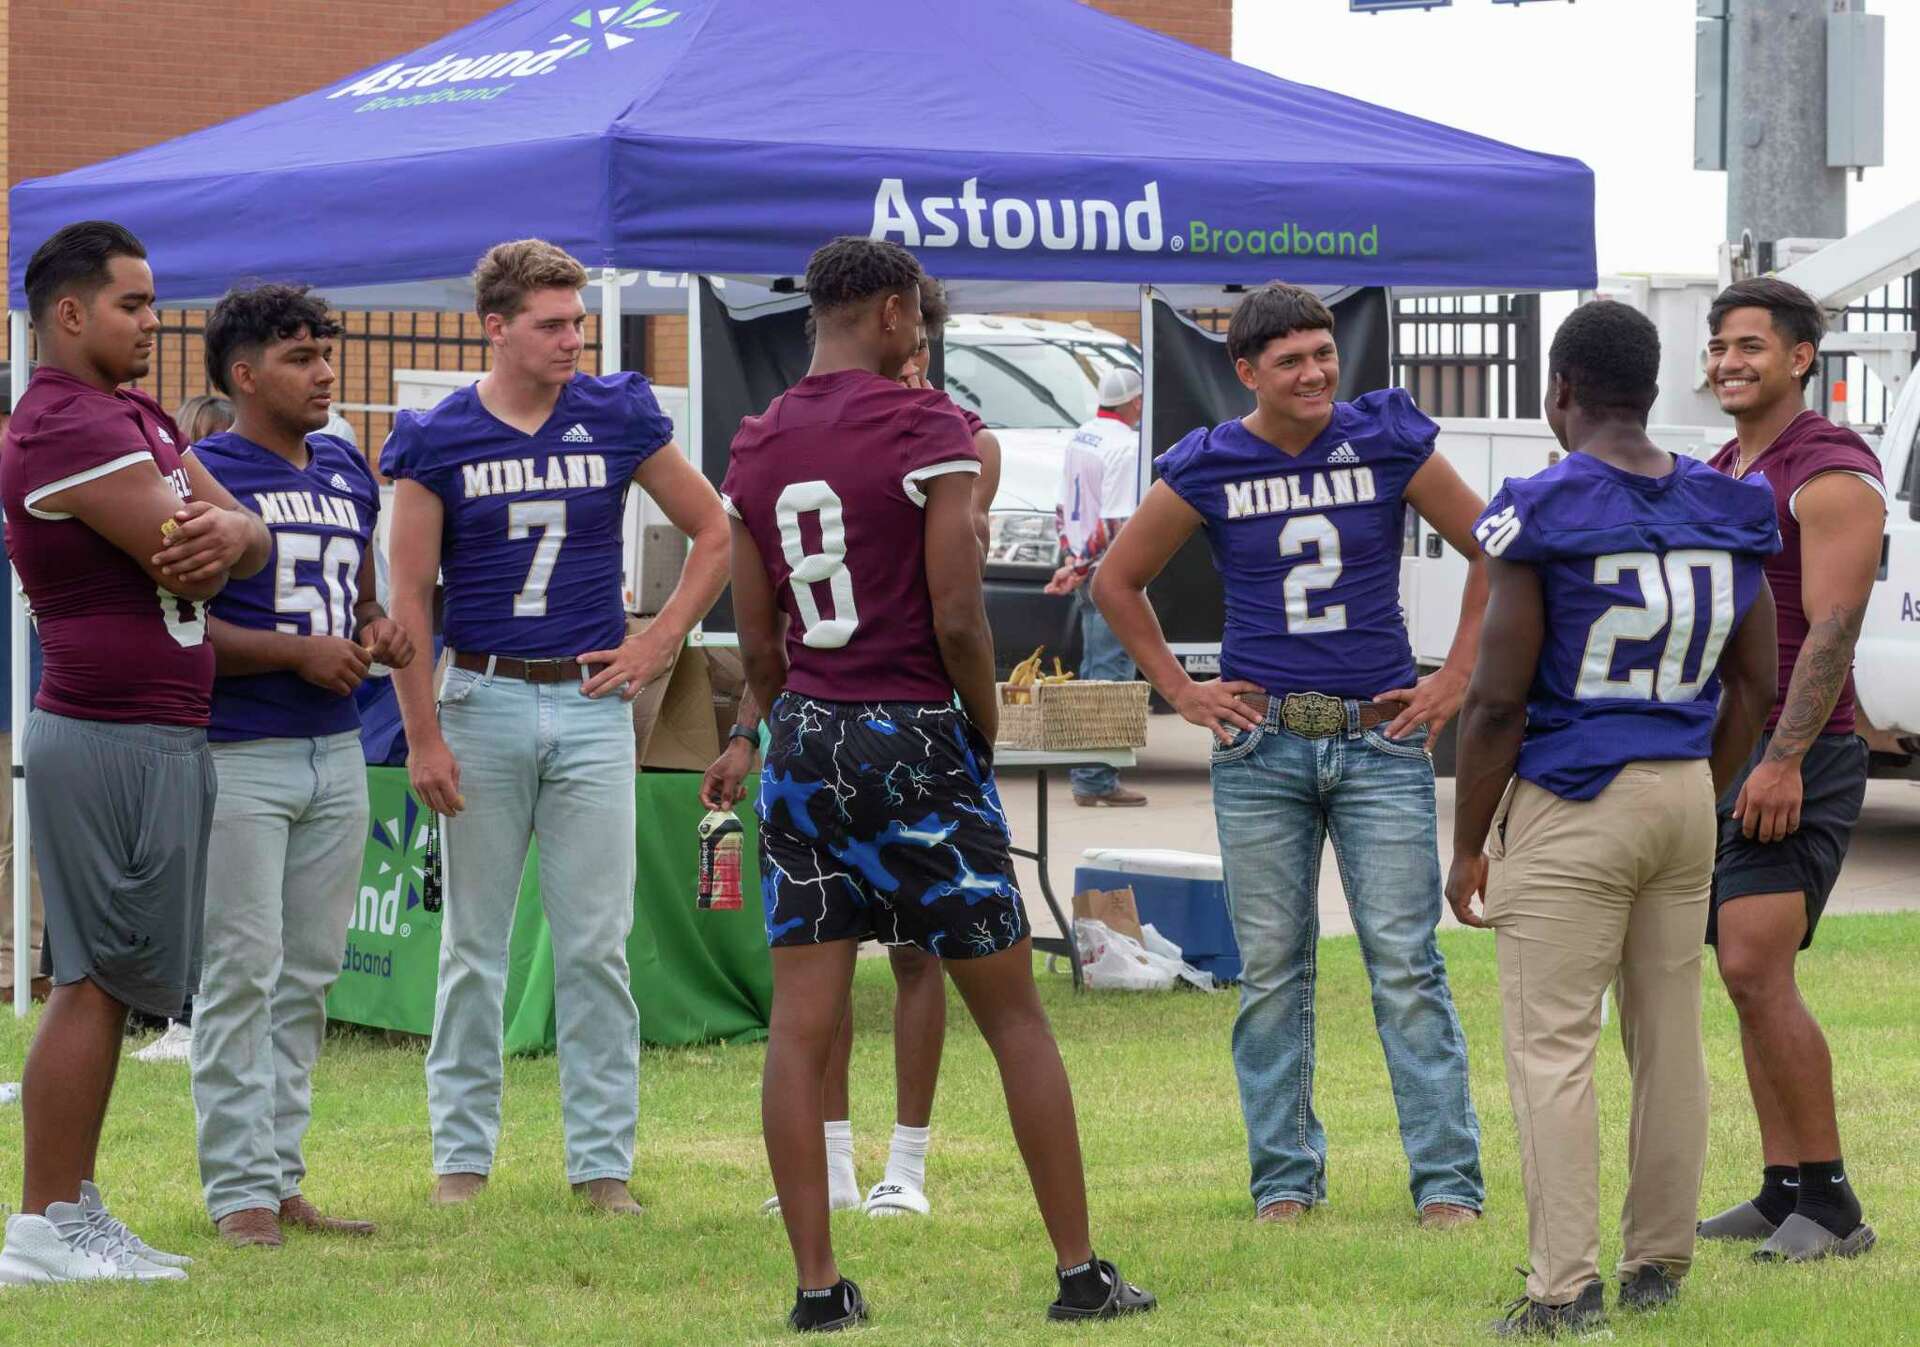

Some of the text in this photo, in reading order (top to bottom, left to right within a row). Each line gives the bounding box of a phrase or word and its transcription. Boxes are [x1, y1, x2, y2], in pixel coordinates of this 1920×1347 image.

[1189, 221, 1379, 256] Broadband
[561, 434, 593, 443] adidas
[462, 454, 608, 498] MIDLAND
[1224, 466, 1376, 519] MIDLAND
[508, 499, 567, 617] 7
[1476, 505, 1522, 558] 20
[275, 532, 361, 640] 50
[775, 480, 859, 648] 8
[1278, 513, 1347, 634] 2
[1574, 550, 1734, 703] 20
[876, 1185, 904, 1193] NIKE
[803, 1288, 832, 1298] PUMA
[1061, 1263, 1091, 1279] PUMA
